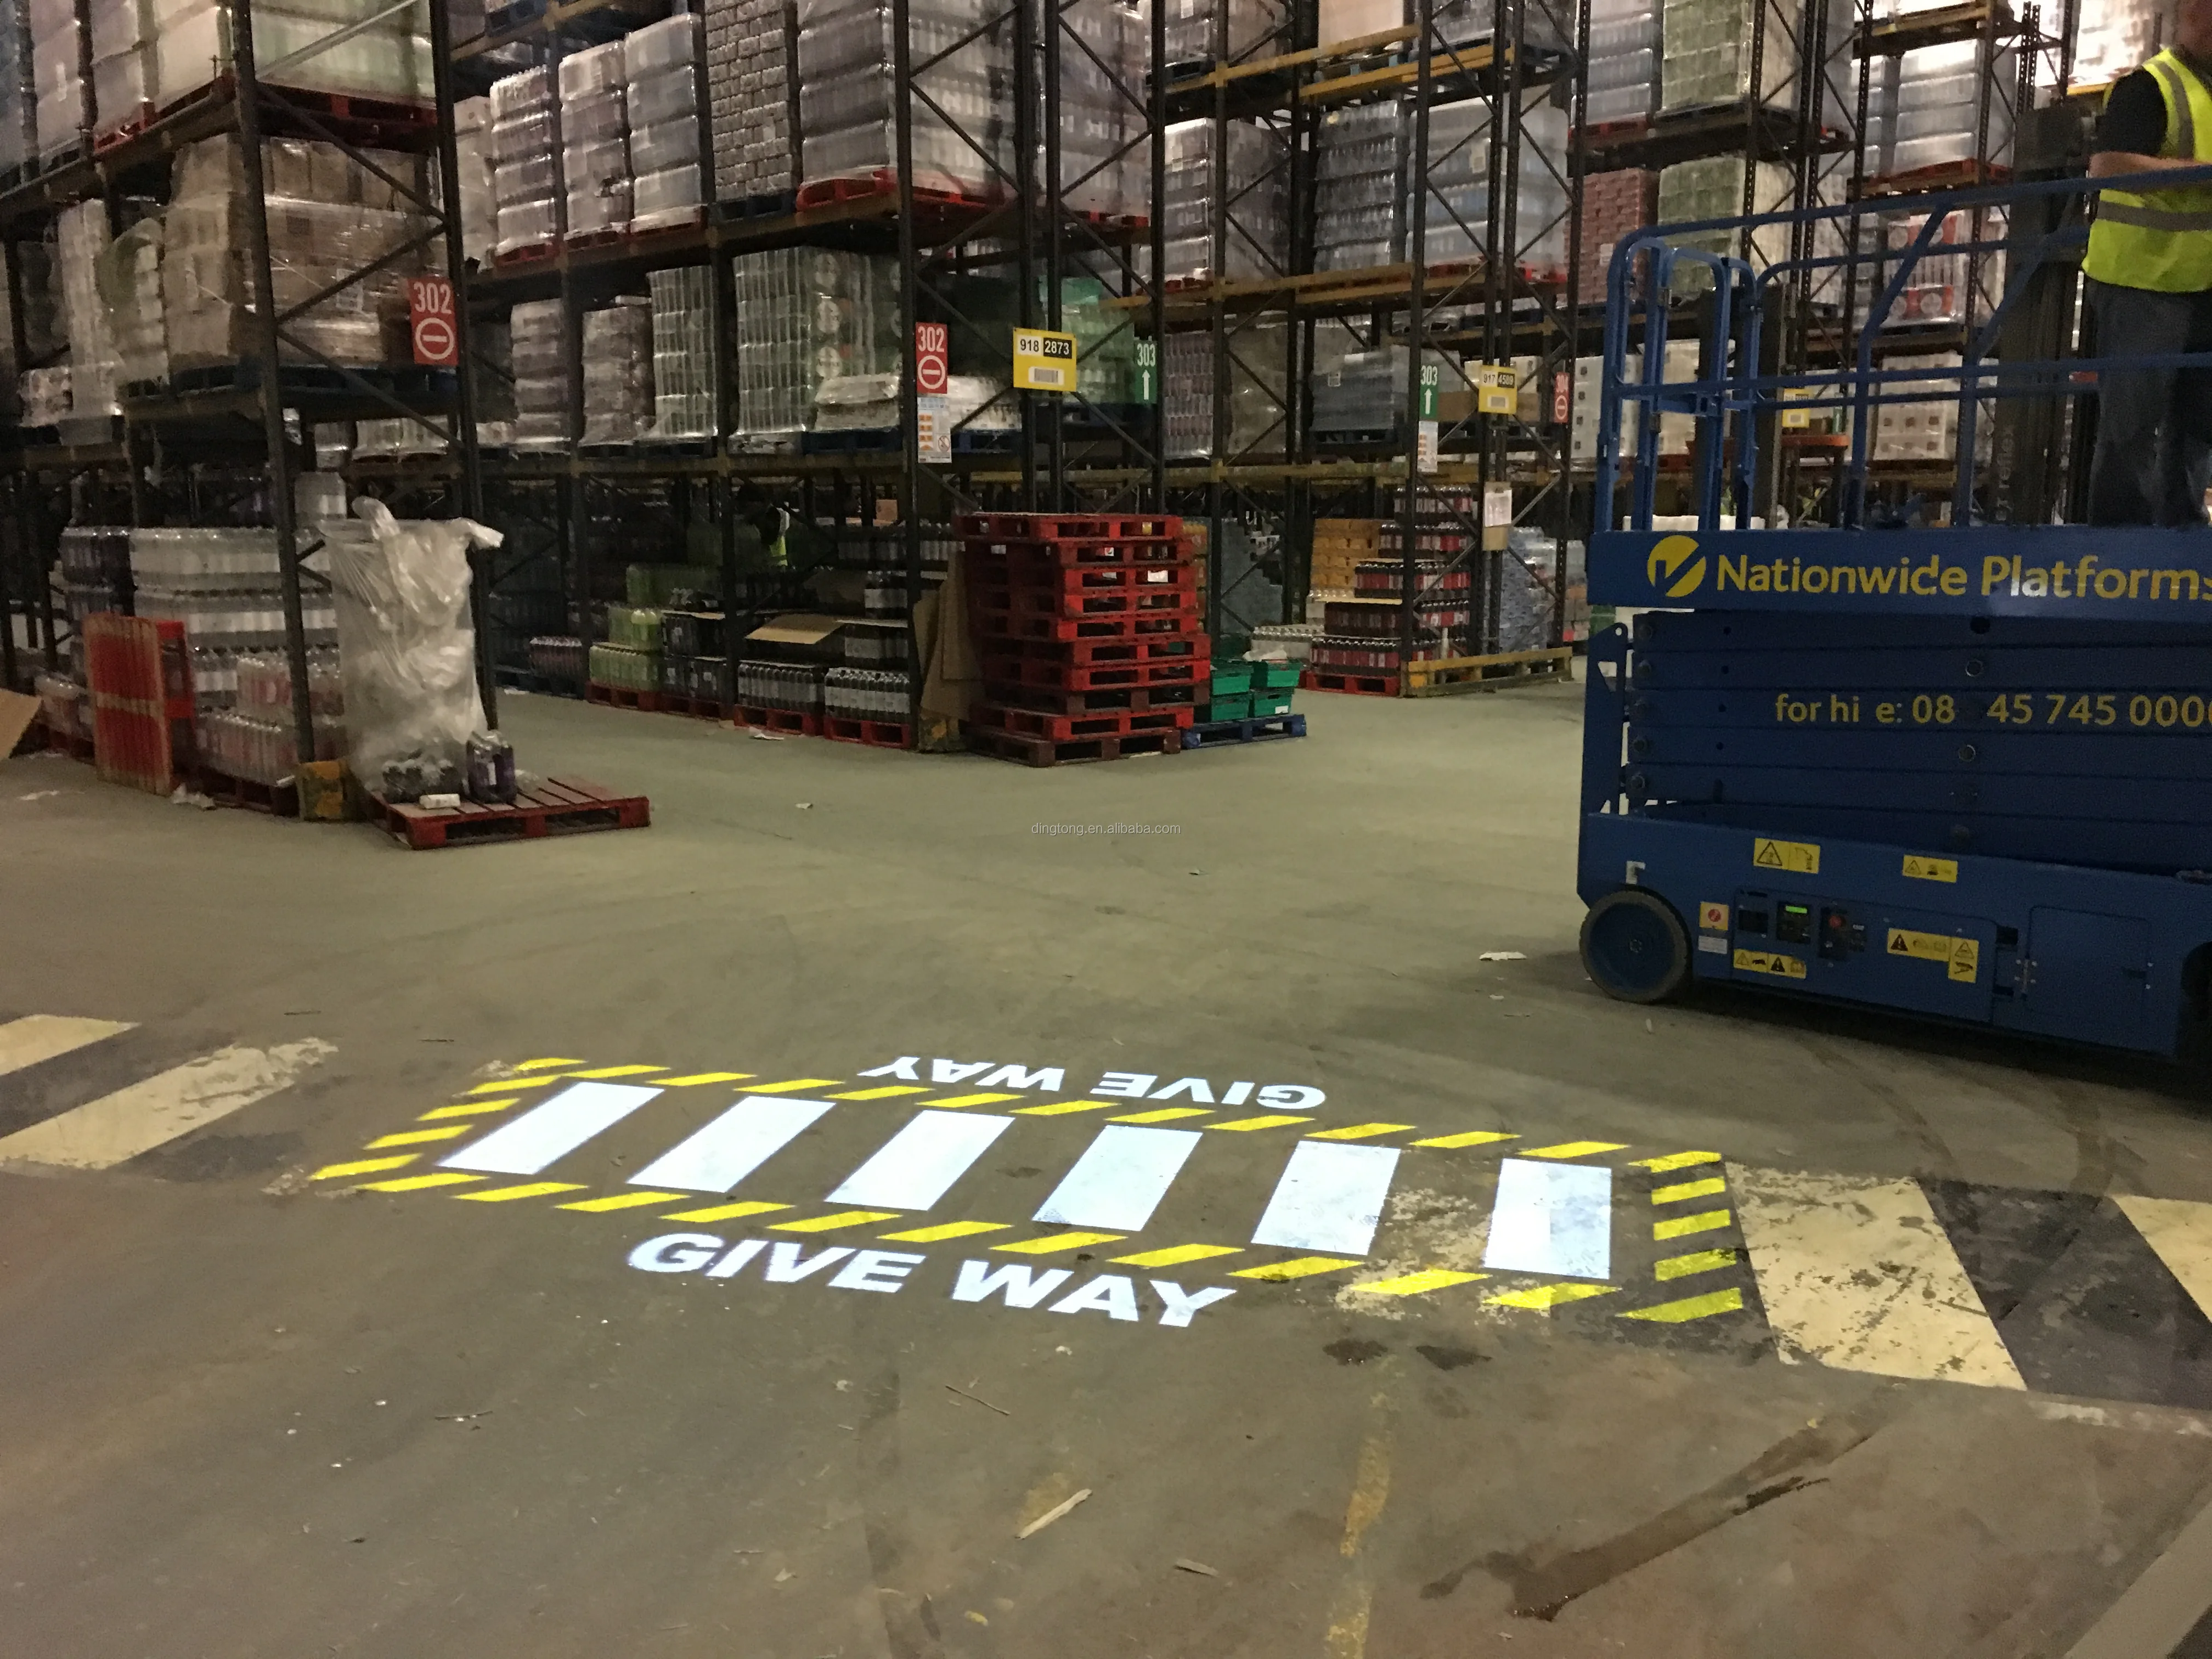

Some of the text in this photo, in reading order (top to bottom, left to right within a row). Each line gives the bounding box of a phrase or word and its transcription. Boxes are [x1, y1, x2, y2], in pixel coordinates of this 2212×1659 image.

[413, 281, 452, 314] 302
[917, 326, 945, 353] 302
[1020, 338, 1070, 355] 918 2873
[1136, 343, 1156, 366] 303
[1420, 365, 1438, 386] 303
[1483, 374, 1496, 383] 917
[1717, 554, 1968, 595] Nationwide
[1775, 693, 1821, 723] for
[2046, 694, 2117, 726] 745
[2129, 695, 2212, 727] 000
[857, 1056, 1326, 1109] GIVE WAY
[627, 1232, 1238, 1328] GIVE WAY
